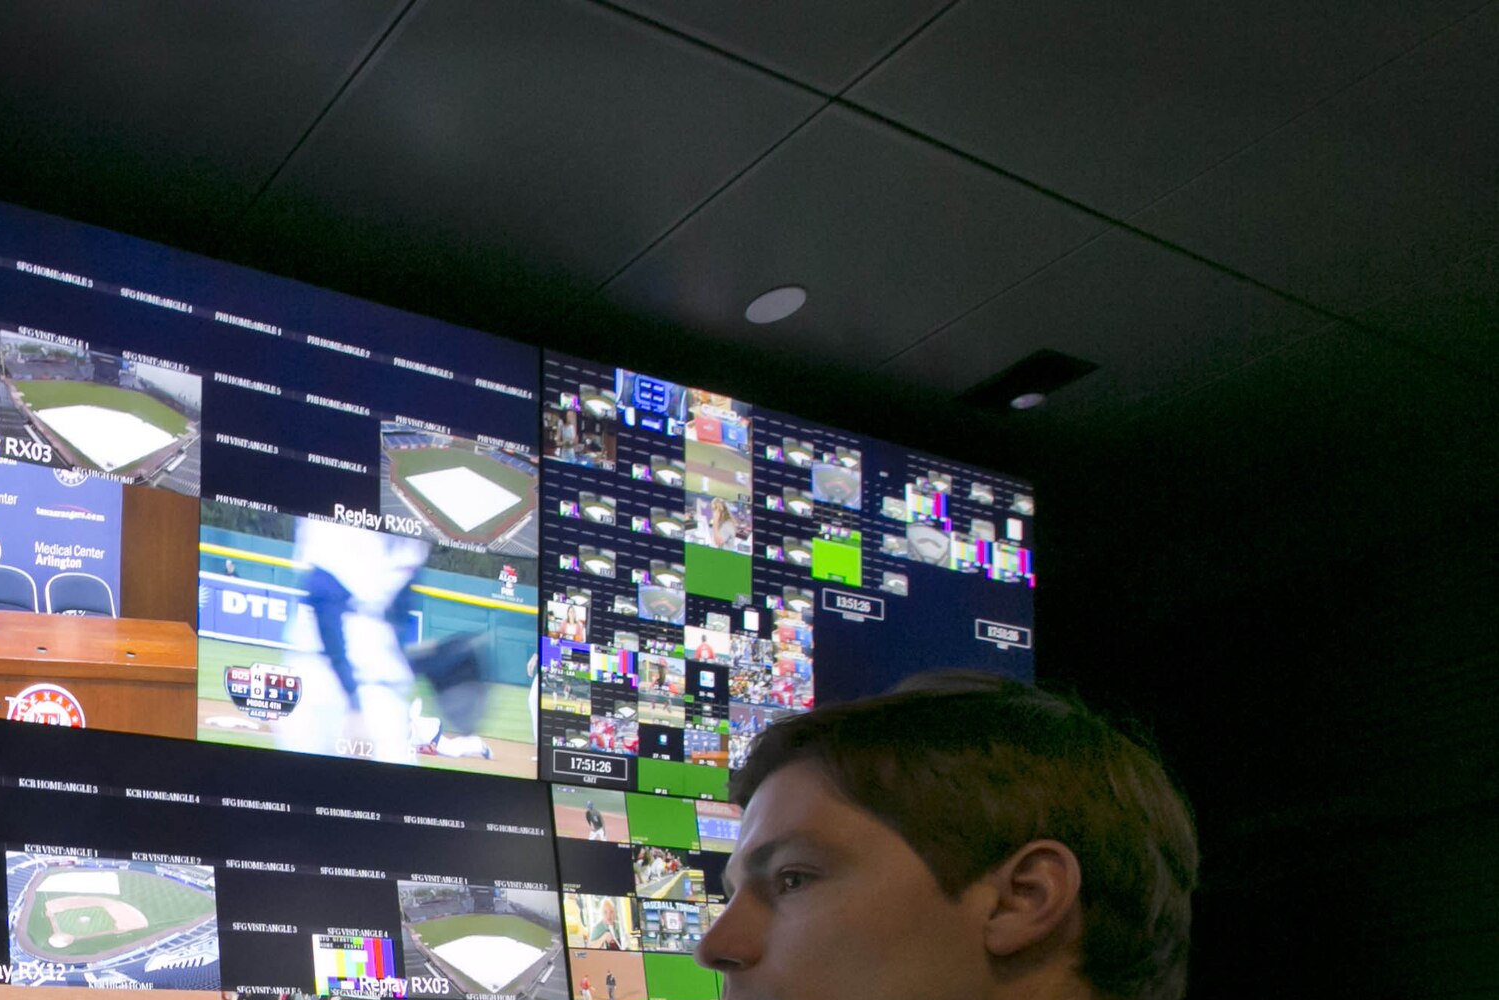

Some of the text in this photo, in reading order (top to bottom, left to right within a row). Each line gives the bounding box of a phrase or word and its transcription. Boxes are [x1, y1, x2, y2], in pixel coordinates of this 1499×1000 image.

[6, 437, 52, 463] RX03
[334, 504, 422, 536] Replay RX05
[34, 541, 105, 560] Medical Center
[35, 554, 82, 569] Arlington
[222, 590, 287, 621] DTE
[231, 670, 250, 680] BOS
[269, 676, 278, 685] 7
[231, 683, 248, 694] DET
[570, 757, 612, 774] 17:51:26
[18, 963, 67, 982] RX12
[359, 976, 450, 995] Replay RX03
